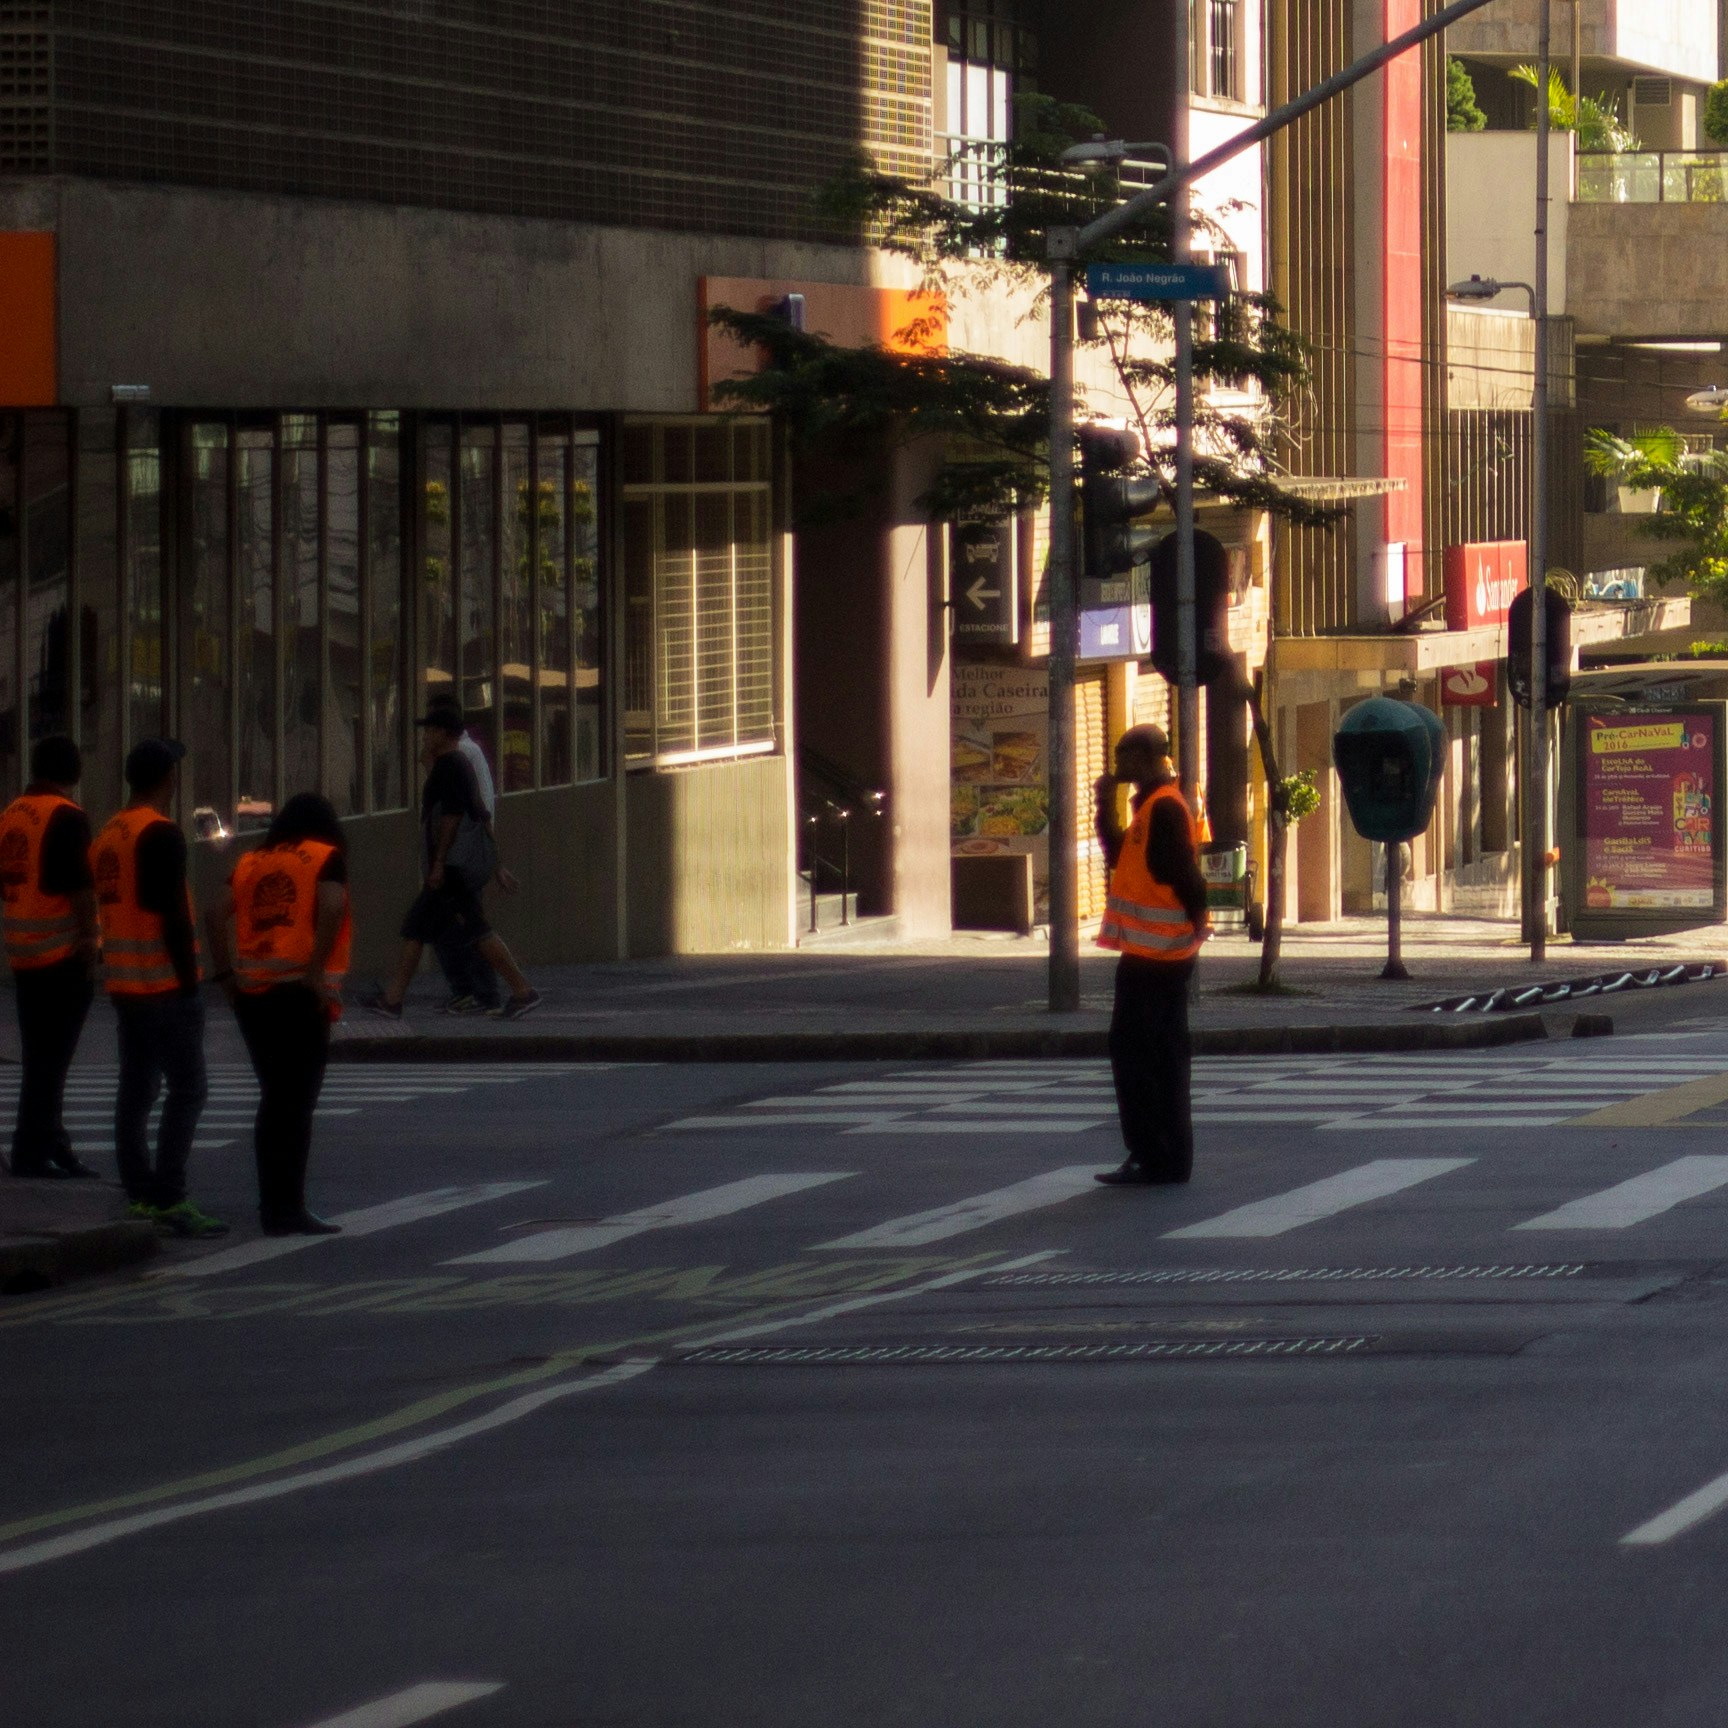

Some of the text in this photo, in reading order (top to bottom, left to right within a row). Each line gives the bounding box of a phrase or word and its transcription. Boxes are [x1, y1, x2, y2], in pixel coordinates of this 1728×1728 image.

[1102, 272, 1185, 285] R. João Negrão
[1486, 560, 1518, 612] Santander
[983, 683, 1048, 698] Caseira
[965, 700, 1014, 718] região
[1604, 741, 1629, 751] 2016
